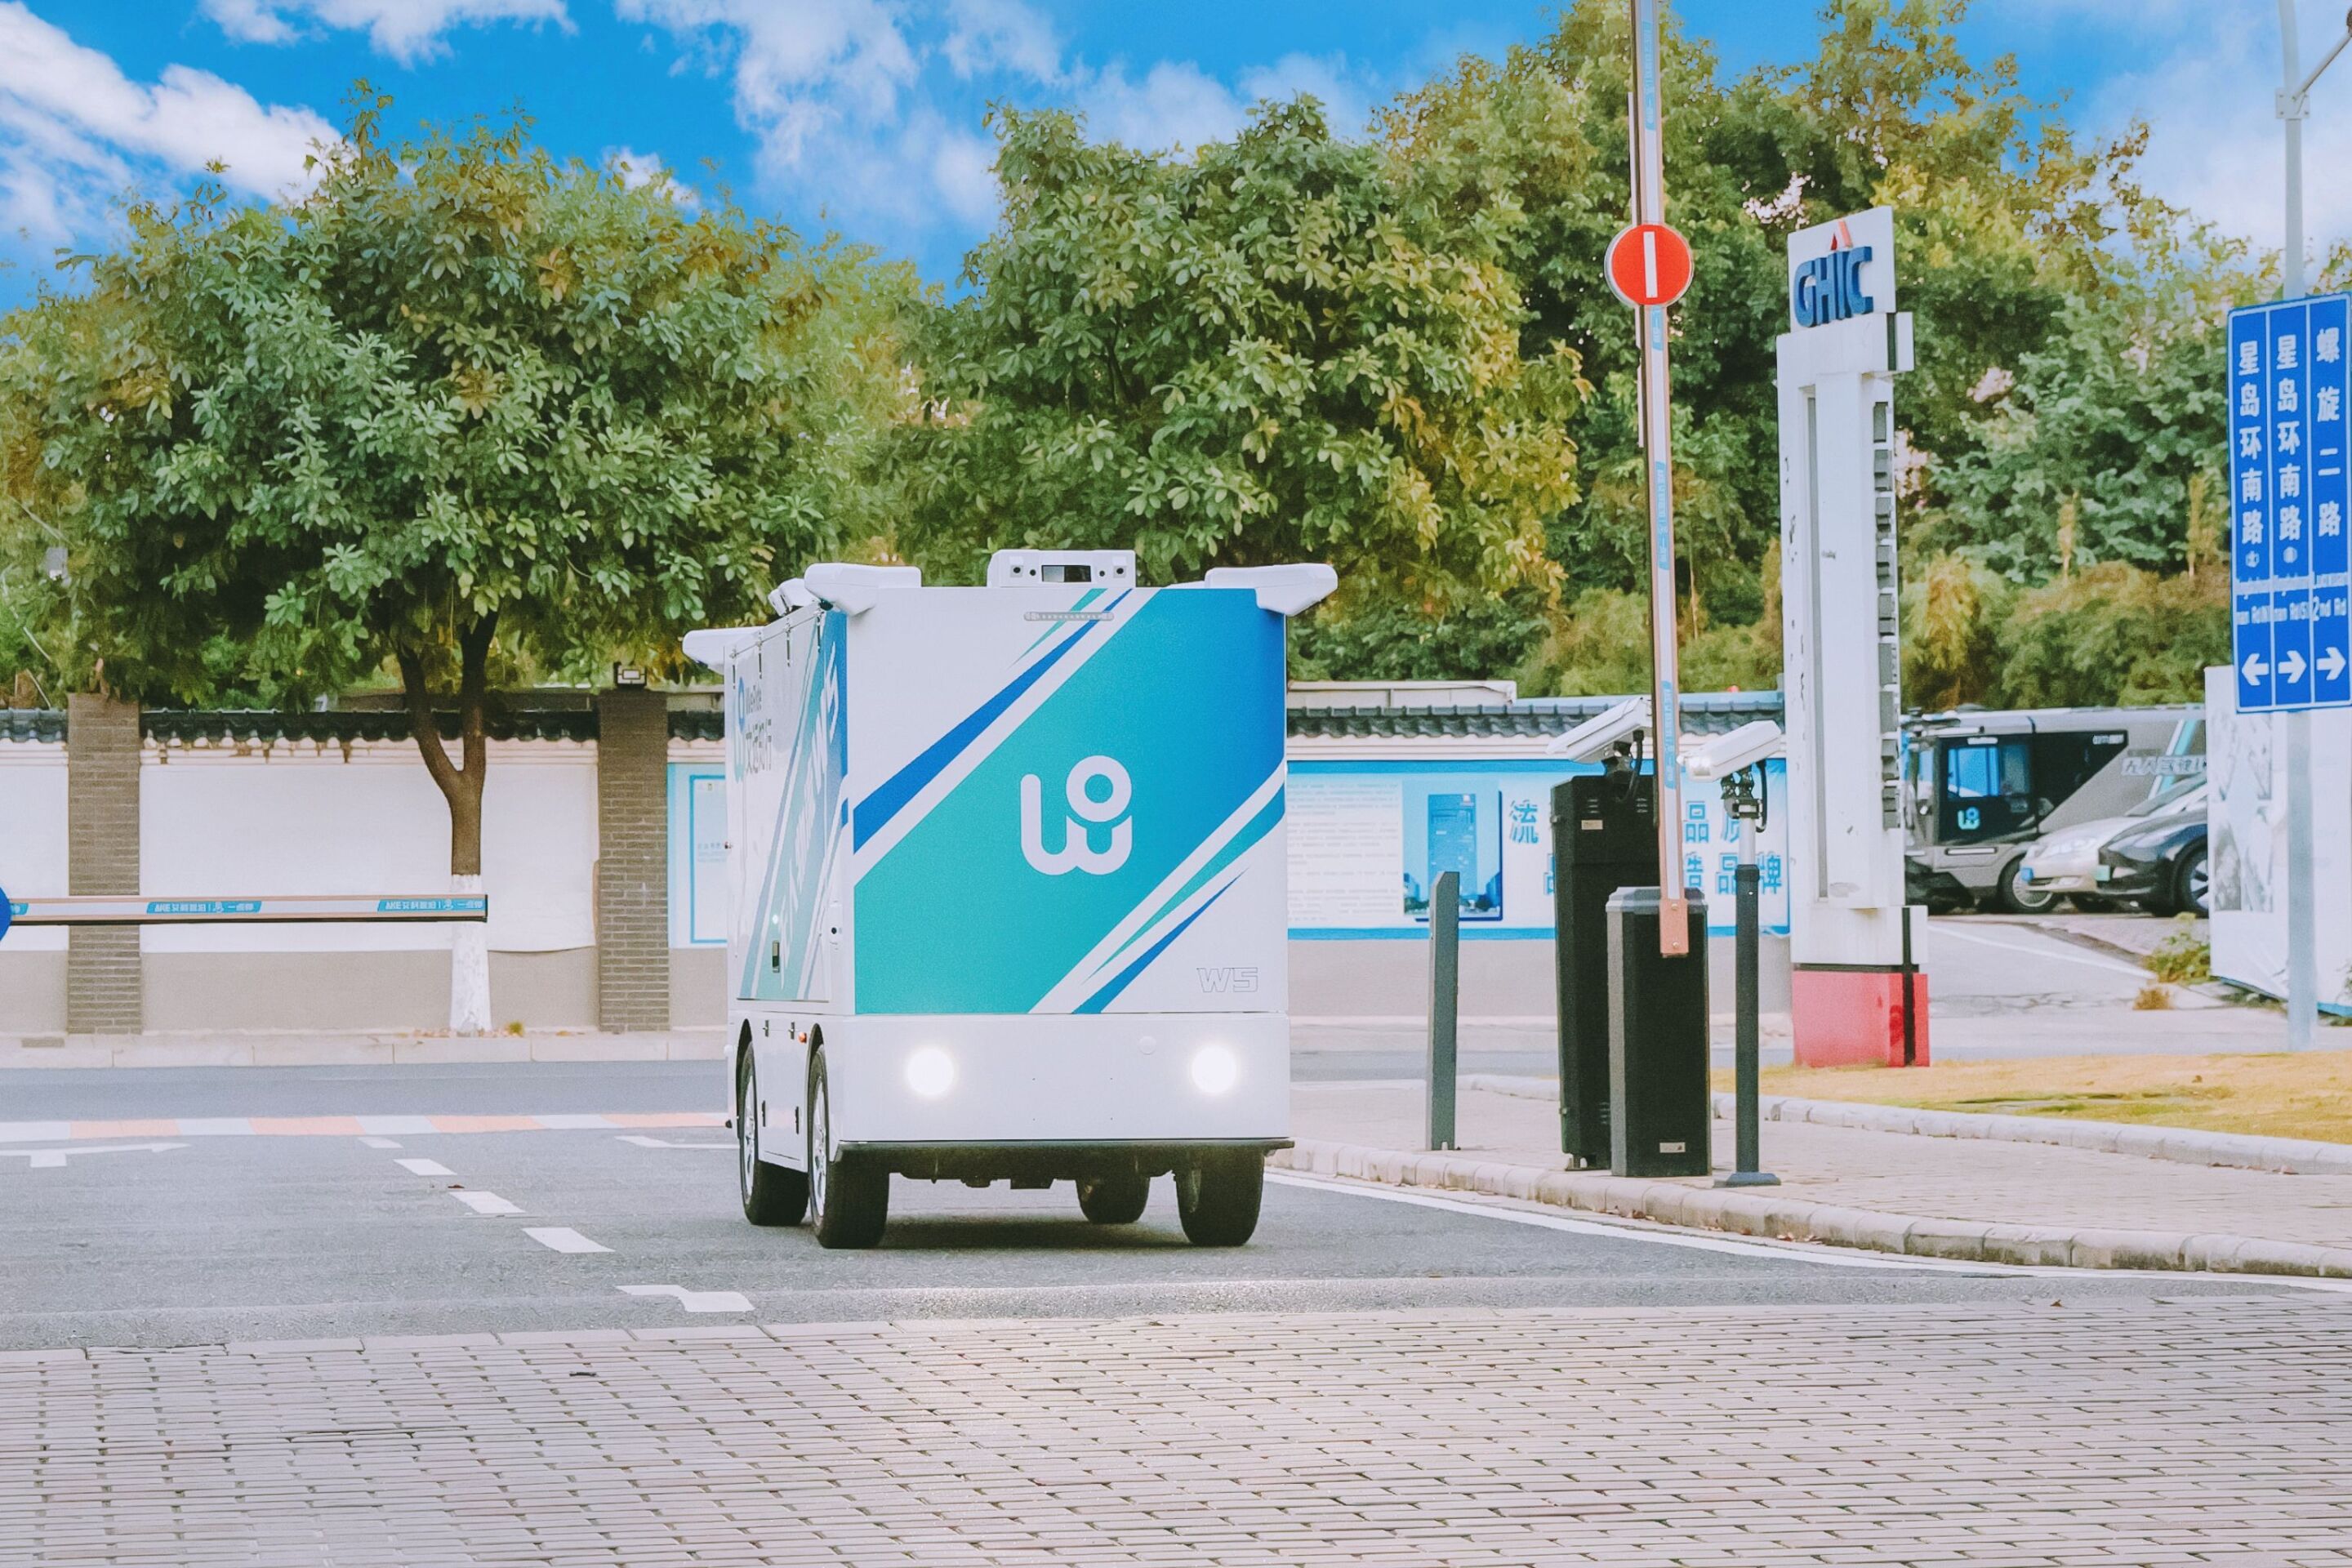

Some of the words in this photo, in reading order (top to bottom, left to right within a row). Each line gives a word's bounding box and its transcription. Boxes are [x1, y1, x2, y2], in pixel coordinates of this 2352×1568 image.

[2238, 341, 2264, 546] 星岛环南路
[2277, 334, 2302, 542] 星岛环南路
[2316, 327, 2342, 539] 螺旋二路
[1196, 967, 1258, 992] W5
